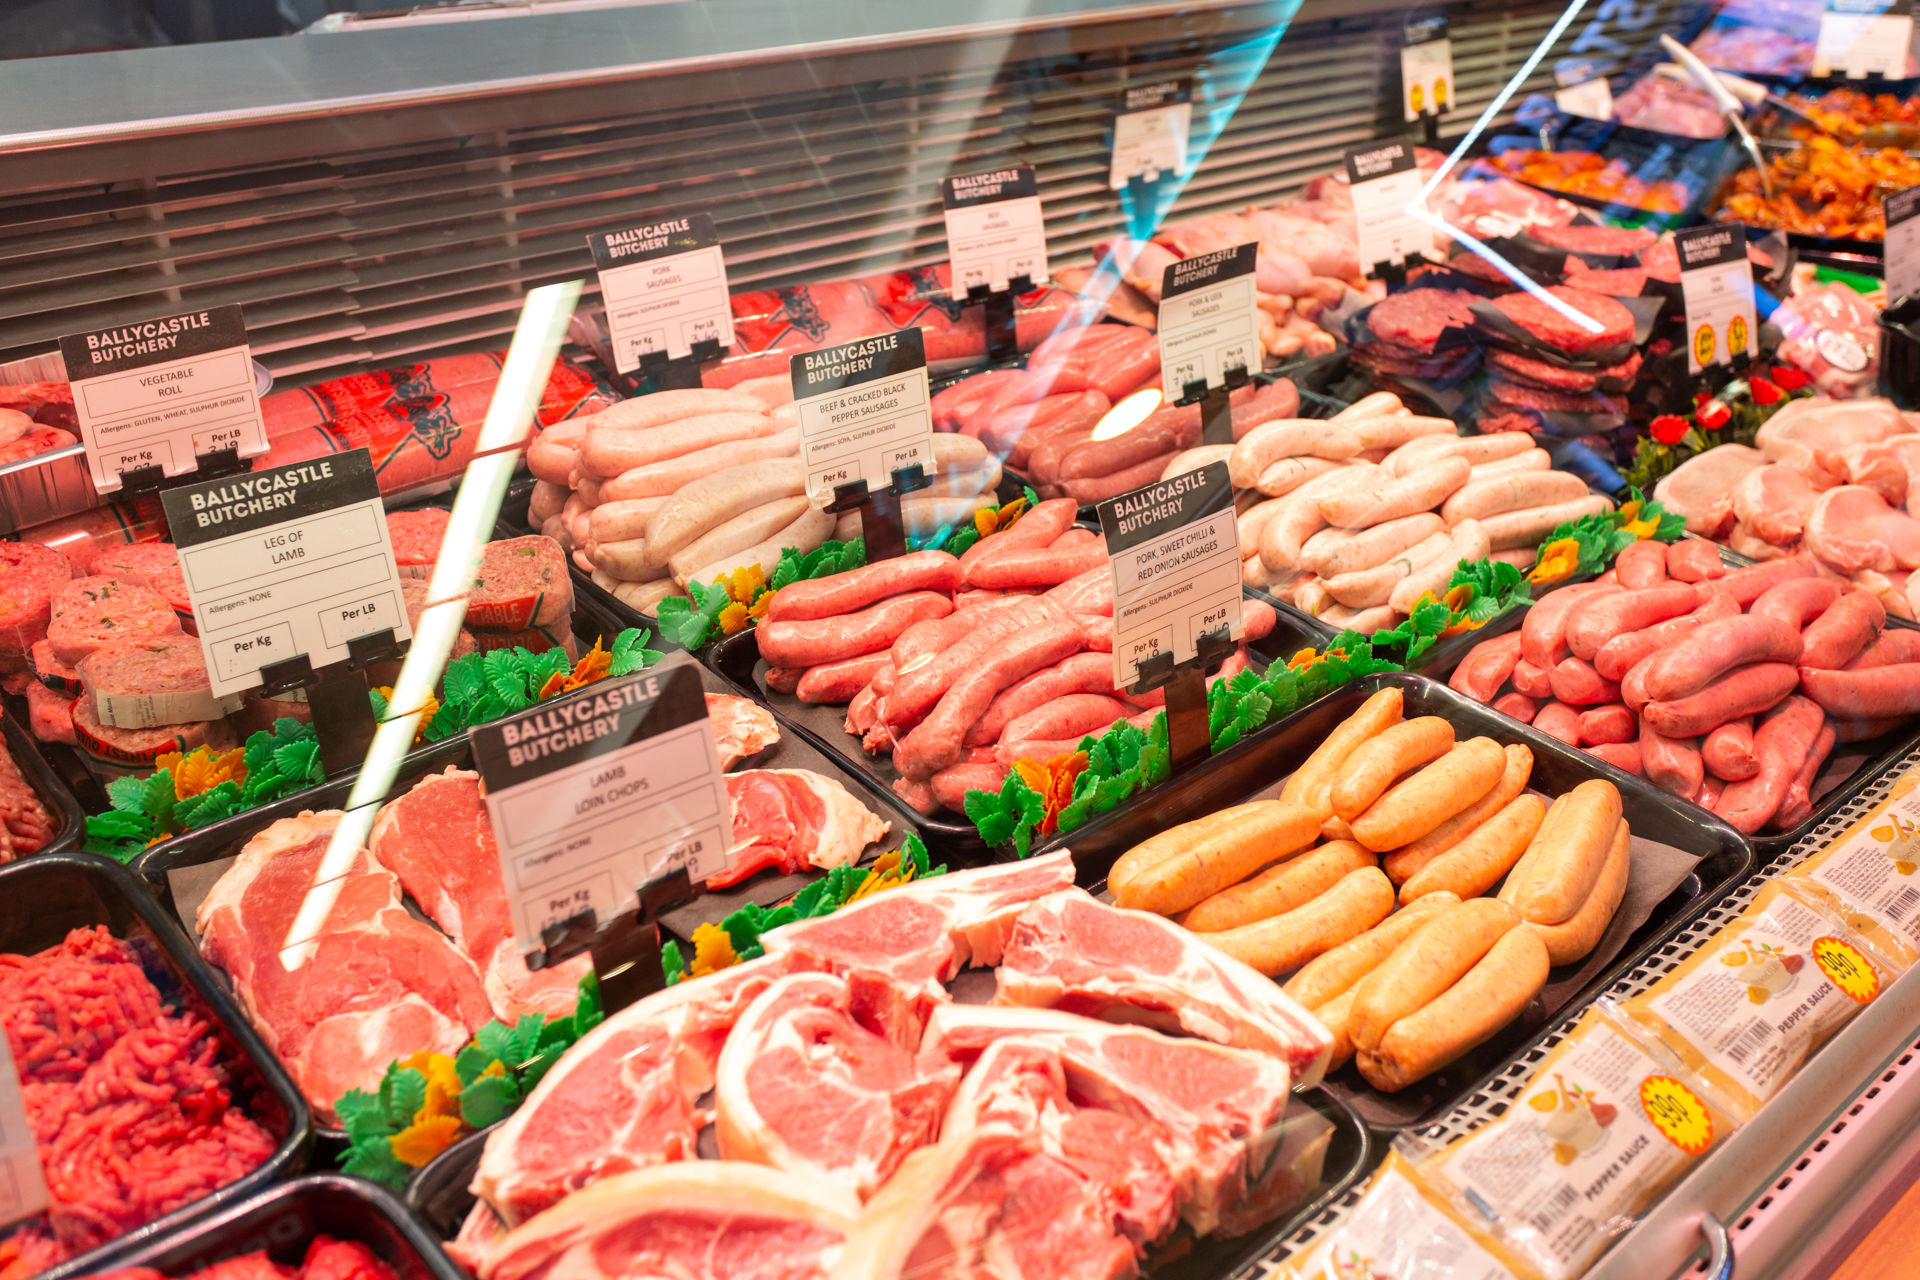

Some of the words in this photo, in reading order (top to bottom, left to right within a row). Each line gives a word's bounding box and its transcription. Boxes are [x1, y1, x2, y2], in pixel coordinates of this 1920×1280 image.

[605, 218, 691, 247] BALLYCASTLE
[609, 236, 670, 259] BUTCHERY
[652, 266, 671, 275] PORK
[1174, 247, 1238, 276] BALLYCASTLE
[646, 275, 682, 289] SAUSAGES
[1173, 264, 1219, 287] BUTCHERY
[86, 312, 211, 350] BALLYCASTLE
[694, 323, 705, 331] Per
[707, 320, 715, 328] LB
[91, 334, 178, 364] BUTCHERY
[630, 339, 641, 347] Per
[805, 335, 898, 371] BALLYCASTLE
[139, 368, 194, 387] VEGETABLE
[808, 357, 874, 385] BUTCHERY
[158, 385, 183, 397] ROLL
[819, 401, 838, 414] BEEF
[839, 399, 847, 408] &
[847, 389, 882, 407] CRACKED
[883, 383, 906, 396] BLACK
[100, 422, 133, 434] Allergens:
[134, 416, 163, 427] GLUTEN,
[163, 408, 189, 420] WHEAT,
[189, 402, 219, 414] SULPHUR
[220, 396, 245, 407] DIOXIDE
[831, 410, 860, 424] PEPPER
[861, 398, 899, 416] SAUSAGES
[211, 432, 228, 443] Per
[229, 429, 241, 439] LB
[811, 441, 836, 453] Allergens:
[852, 429, 876, 441] SULPHUR
[876, 423, 896, 434] DIOXIDE
[121, 454, 138, 465] Per
[139, 450, 153, 461] Kg
[895, 451, 908, 461] Per
[908, 448, 918, 457] LB
[190, 462, 334, 511] BALLYCASTLE
[823, 472, 836, 483] Per
[837, 470, 847, 479] Kg
[1113, 470, 1207, 519] BALLYCASTLE
[195, 489, 297, 528] BUTCHERY
[1118, 497, 1184, 535] BUTCHERY
[264, 535, 286, 550] LEG
[288, 530, 304, 543] OF
[1136, 550, 1159, 566] PORK,
[1160, 538, 1185, 557] SWEET
[1186, 528, 1209, 544] CHILLI
[1209, 525, 1215, 535] &
[271, 547, 305, 565] LAMB
[1137, 568, 1153, 581] RED
[1154, 557, 1181, 576] ONION
[1181, 540, 1218, 564] SAUSAGES
[208, 599, 247, 615] Allergens:
[248, 591, 272, 604] NONE
[341, 608, 360, 621] Per
[362, 603, 376, 615] LB
[1123, 602, 1148, 617] Allergens:
[1148, 591, 1172, 607] SULPHUR
[1172, 582, 1193, 598] DIOXIDE
[1203, 615, 1217, 625] Per
[1217, 608, 1226, 620] LB
[233, 639, 254, 653] Per
[256, 635, 272, 648] Kg
[1134, 643, 1147, 654] Per
[1148, 638, 1158, 648] Kg
[501, 676, 660, 748] BALLYCASTLE
[508, 713, 620, 768] BUTCHERY
[590, 766, 626, 788] LAMB
[574, 794, 605, 815] LOIN
[607, 777, 649, 802] CHOPS
[567, 836, 591, 851] NONE
[667, 848, 686, 863] Per
[688, 841, 703, 855] LB
[549, 897, 571, 911] Per
[573, 889, 591, 901] Kg
[1821, 951, 1861, 981] 99p
[1777, 1003, 1811, 1034] PEPPER
[1806, 982, 1833, 1006] SAUCE
[1650, 1094, 1693, 1128] 99p
[1584, 1163, 1621, 1202] PEPPER
[1619, 1134, 1650, 1165] SAUCE
